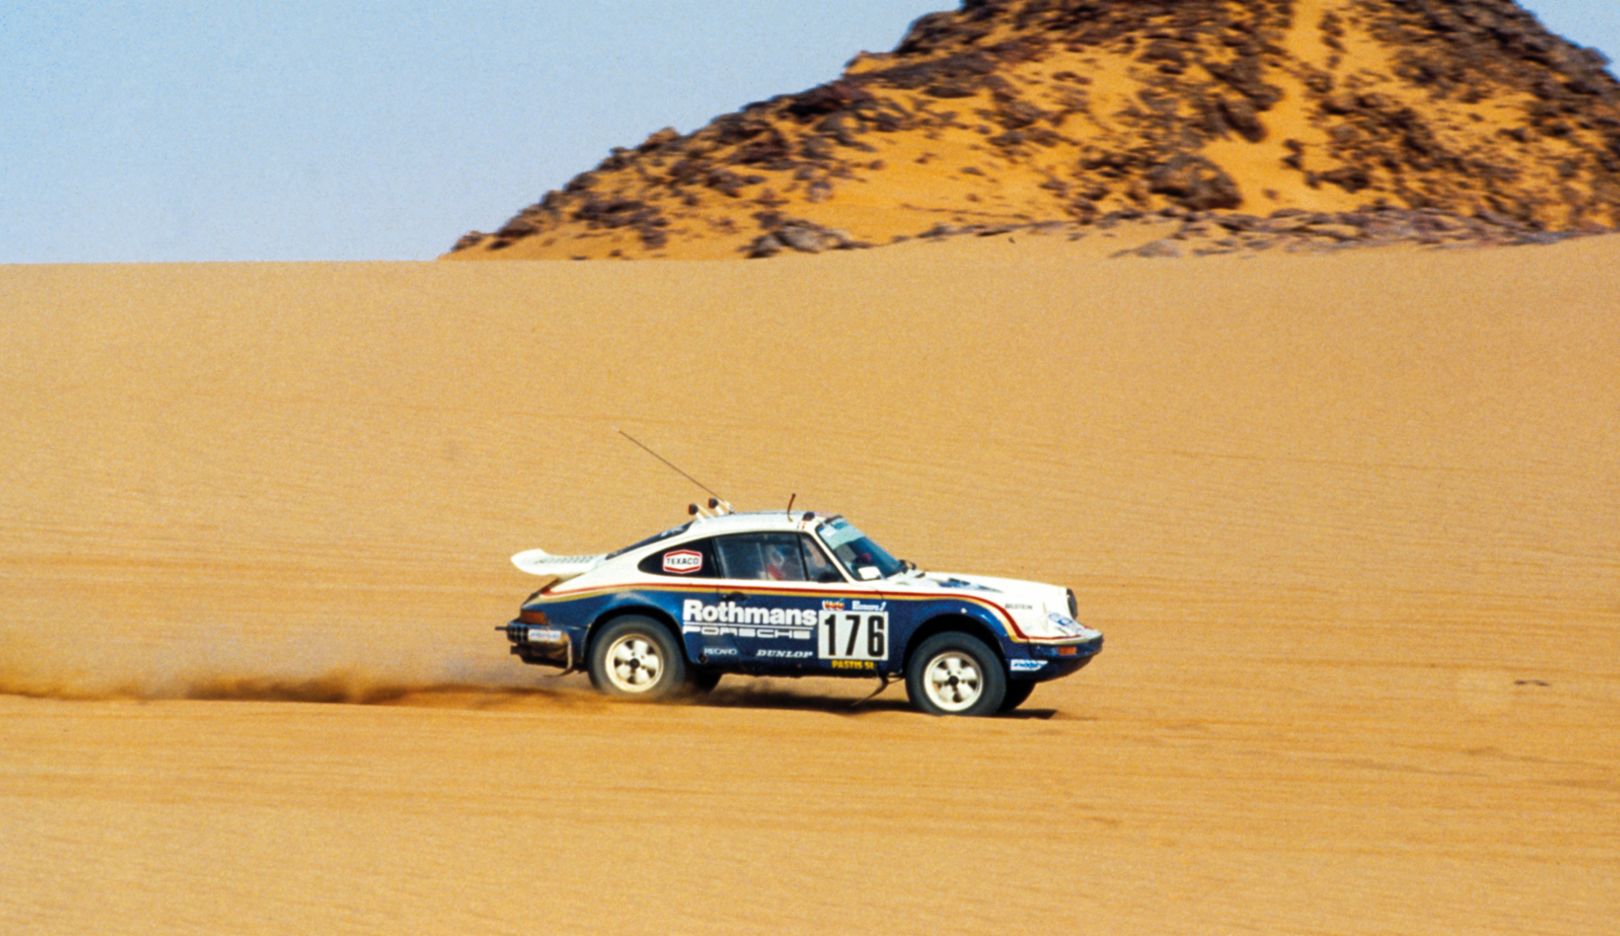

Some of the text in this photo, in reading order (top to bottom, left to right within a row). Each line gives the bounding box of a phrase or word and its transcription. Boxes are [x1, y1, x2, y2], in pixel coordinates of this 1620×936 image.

[667, 557, 700, 565] TEXACO
[682, 599, 818, 626] Rothmans
[682, 626, 811, 639] PORSCHE
[824, 614, 885, 657] 176
[756, 648, 814, 659] DUNLOP
